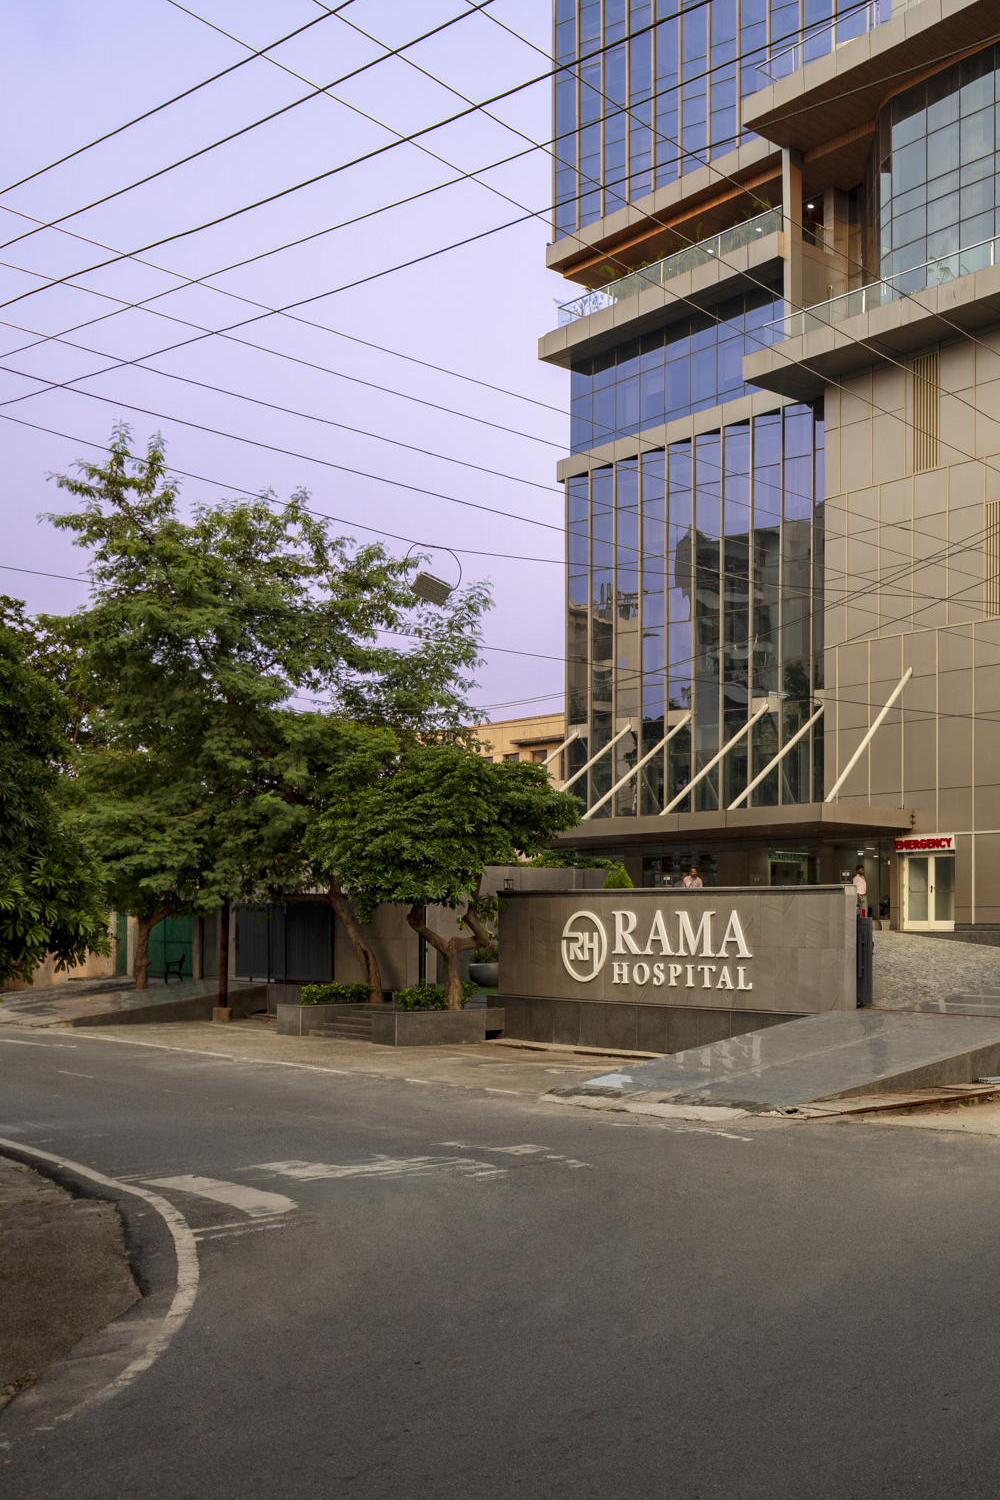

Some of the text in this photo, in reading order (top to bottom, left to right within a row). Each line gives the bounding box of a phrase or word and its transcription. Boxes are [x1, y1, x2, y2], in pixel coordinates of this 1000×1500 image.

[895, 837, 952, 850] EMERGENCY
[767, 853, 807, 863] PHARMACY
[612, 909, 753, 958] RAMA
[612, 961, 753, 991] HOSPITAL
